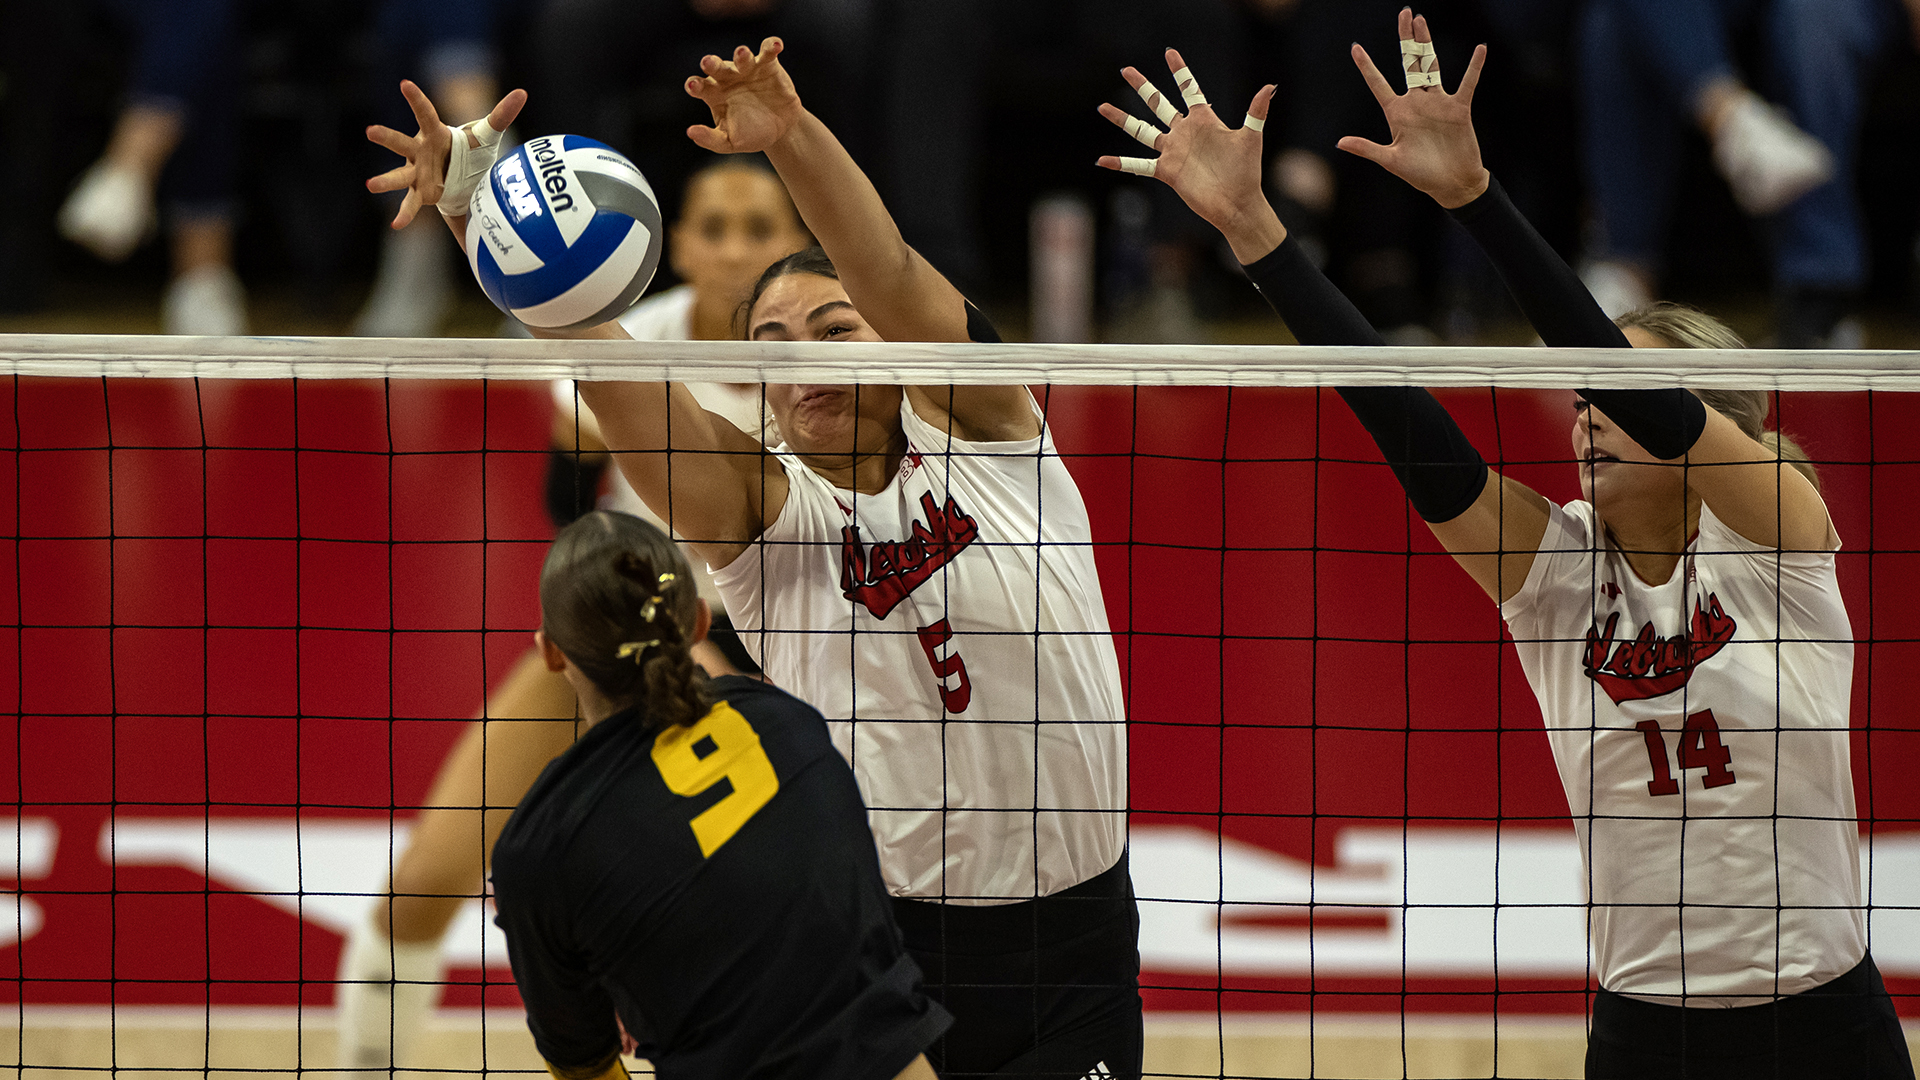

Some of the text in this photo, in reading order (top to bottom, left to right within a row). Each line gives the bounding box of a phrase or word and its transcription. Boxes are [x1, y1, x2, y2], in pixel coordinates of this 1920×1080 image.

[498, 153, 540, 222] NCAA
[529, 138, 574, 213] molten
[481, 214, 514, 255] Touch
[916, 616, 972, 714] 5
[650, 699, 780, 859] 9
[1635, 707, 1737, 797] 14
